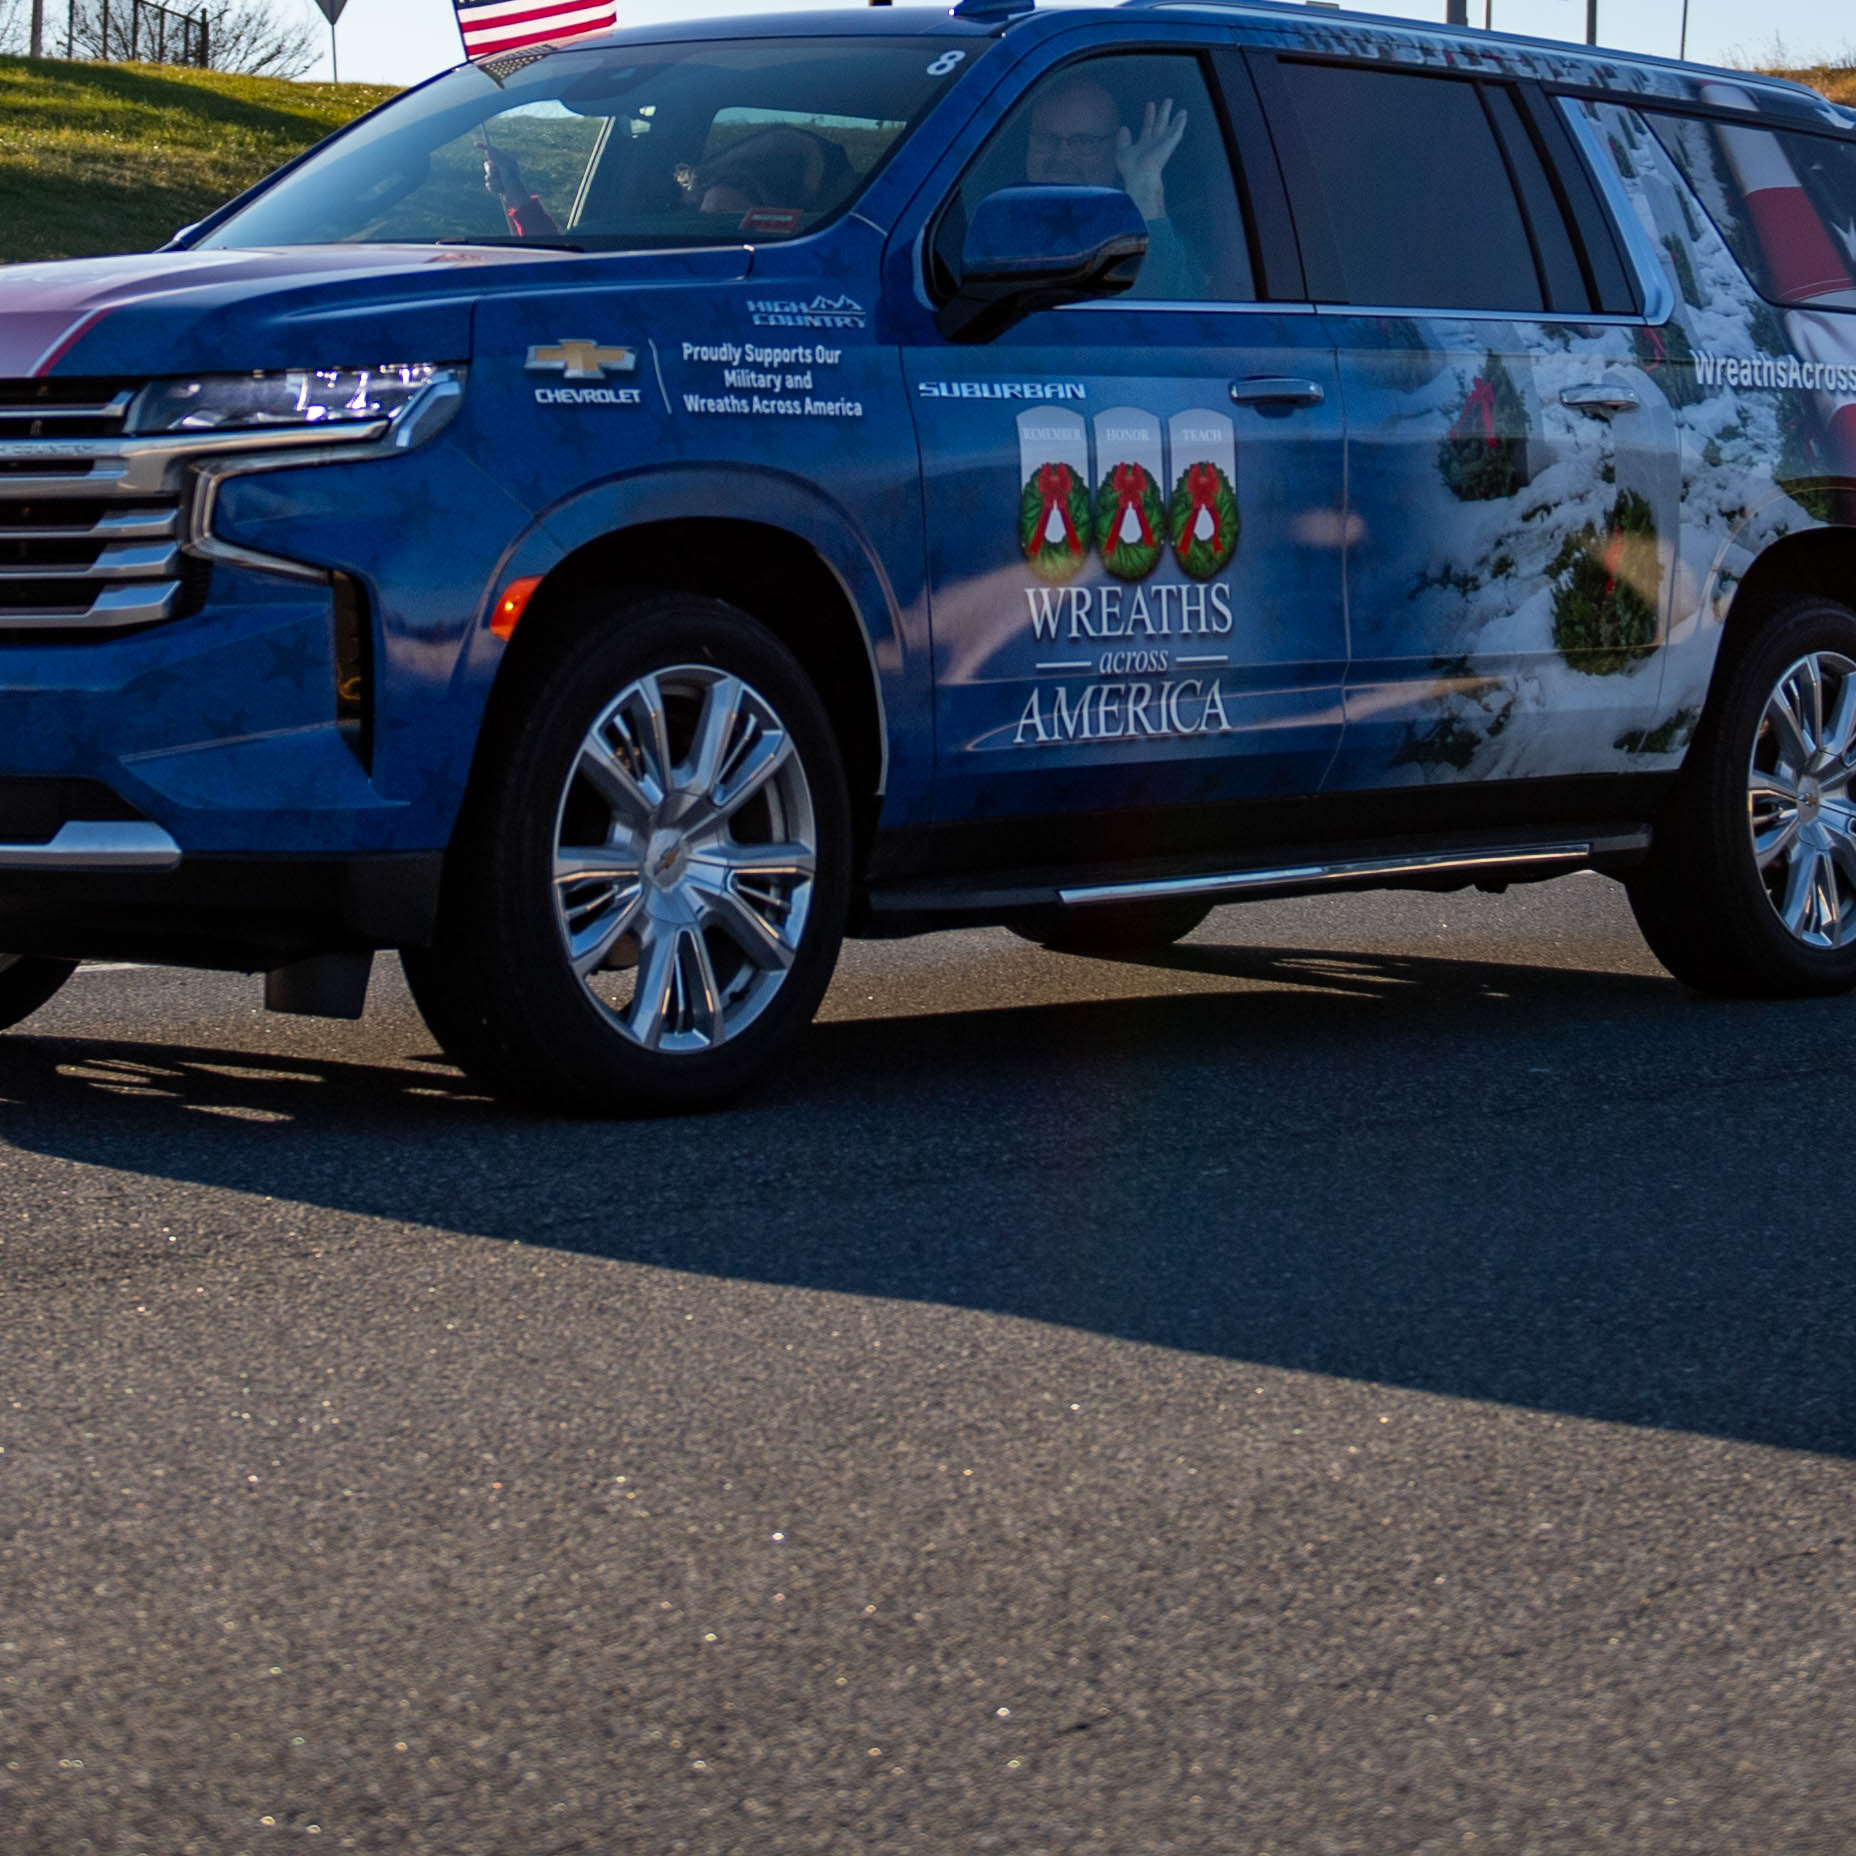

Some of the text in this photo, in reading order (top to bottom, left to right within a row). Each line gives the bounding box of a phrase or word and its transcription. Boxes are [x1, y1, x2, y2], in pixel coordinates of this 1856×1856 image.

[926, 50, 966, 76] 8
[746, 300, 809, 313] HIGH
[752, 313, 865, 328] COUNTRY
[681, 342, 842, 367] Proudly Supports Our
[724, 369, 813, 392] Military and
[918, 381, 1087, 400] SUBURBAN
[534, 388, 642, 404] CHEVROLET
[683, 394, 863, 417] Wreaths Across America
[1105, 428, 1151, 442] HONOR
[1180, 429, 1223, 442] TEACH
[1023, 582, 1234, 641] WREATHS
[1098, 648, 1169, 675] across
[1012, 678, 1233, 745] AMERICA
